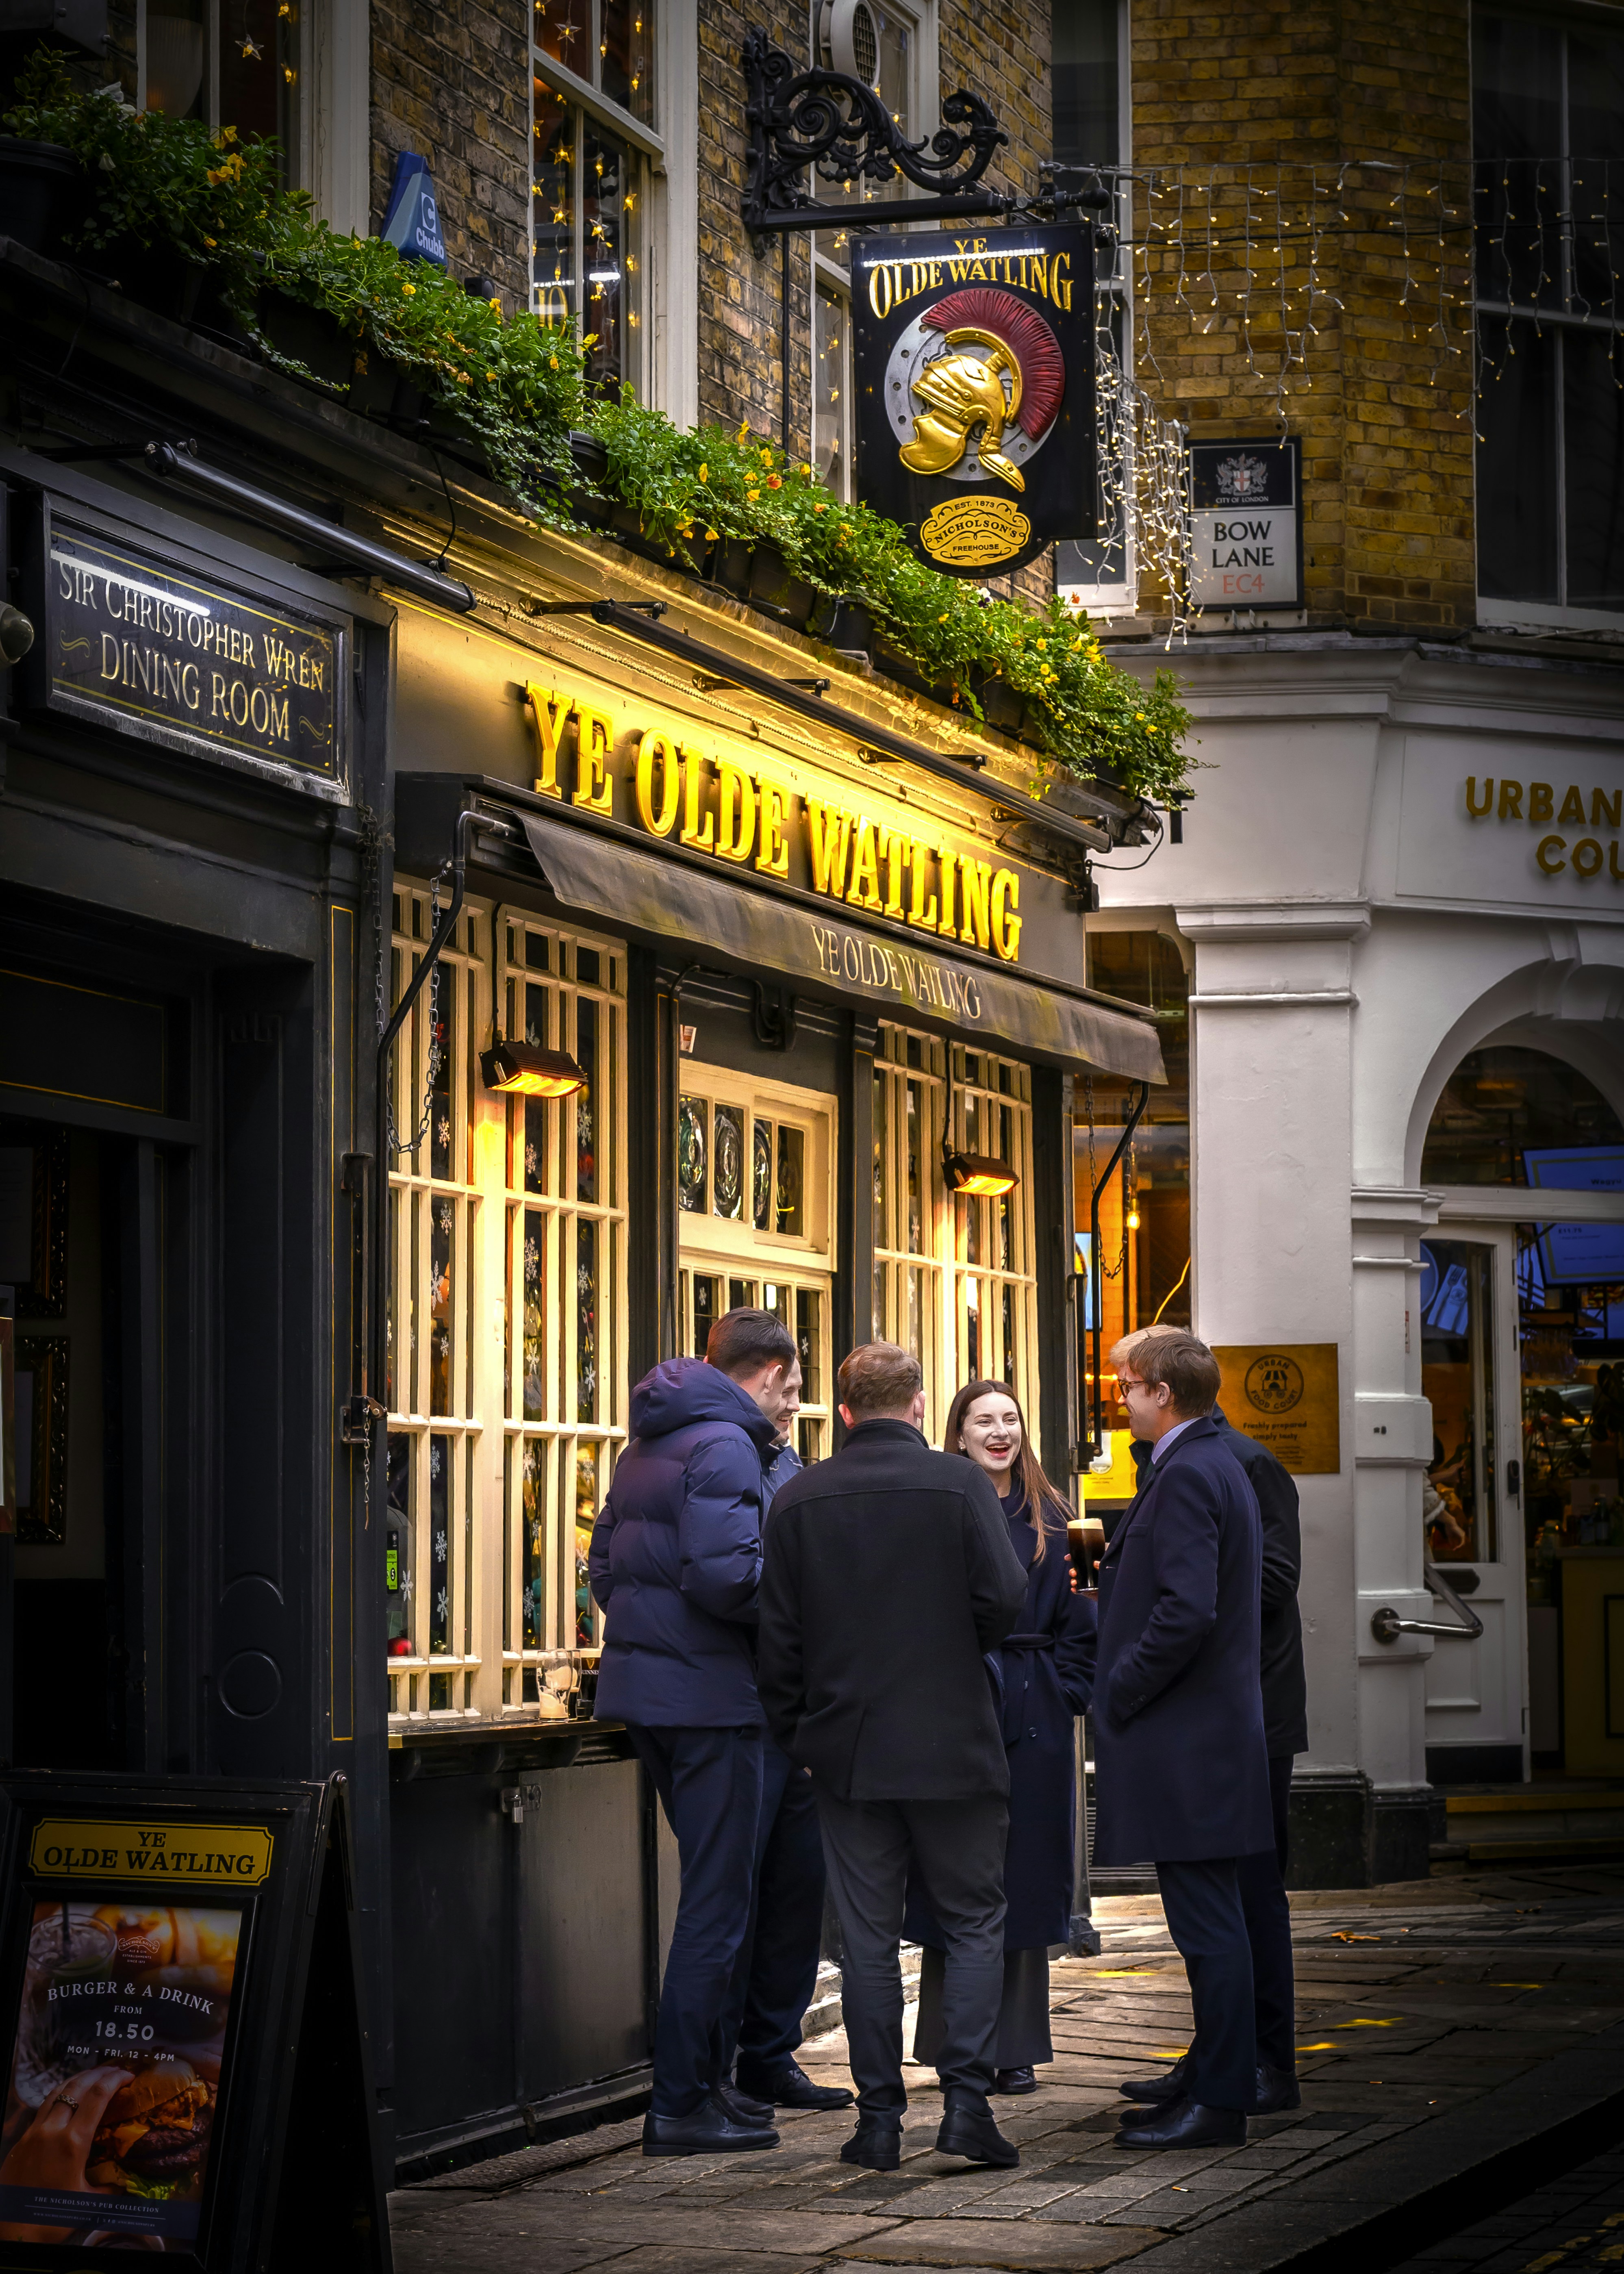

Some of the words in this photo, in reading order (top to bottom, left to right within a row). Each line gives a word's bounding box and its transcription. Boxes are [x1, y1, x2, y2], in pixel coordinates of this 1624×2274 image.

[416, 227, 444, 260] Chubb
[953, 237, 987, 255] YE
[869, 261, 943, 319] OLDE
[947, 252, 1074, 313] WATLING
[954, 501, 972, 510] EST.
[934, 519, 1017, 544] NICHOLSON'S
[1214, 521, 1271, 541] BOW
[1212, 547, 1274, 568] LANE
[1223, 573, 1265, 594] EC4
[60, 560, 98, 610] SIR
[105, 580, 256, 669] CHRISTOPHER
[263, 634, 324, 695] WREN
[100, 630, 200, 710] DINING
[211, 671, 290, 742] ROOM
[1466, 776, 1623, 827] URBAN
[526, 680, 614, 817] YE
[636, 728, 790, 880] OLDE
[805, 792, 1023, 962] WATLING
[811, 924, 840, 976] YE
[844, 936, 903, 991] OLDE
[897, 953, 981, 1019] WATLING
[1257, 1359, 1290, 1370] URBAN
[1251, 1390, 1270, 1408] FOOD
[1274, 1389, 1298, 1409] COURT
[1272, 1421, 1307, 1430] prepared
[1279, 1433, 1298, 1441] tasty
[138, 1831, 167, 1848] YE
[43, 1846, 118, 1869] OLDE
[126, 1850, 255, 1875] WATLING
[122, 1940, 155, 1950] NICHOLSON'S
[48, 1981, 117, 2001] BURGER
[124, 1983, 136, 1995] &
[142, 1984, 153, 1998] A
[159, 1986, 214, 2014] DRINK
[114, 2005, 142, 2015] FROM
[96, 2021, 154, 2040] 18.50
[67, 2046, 89, 2055] MON
[129, 2050, 139, 2059] 12
[154, 2053, 175, 2061] 4PM
[50, 2198, 96, 2207] NICHOLSON'S
[115, 2204, 159, 2213] COLLECTION
